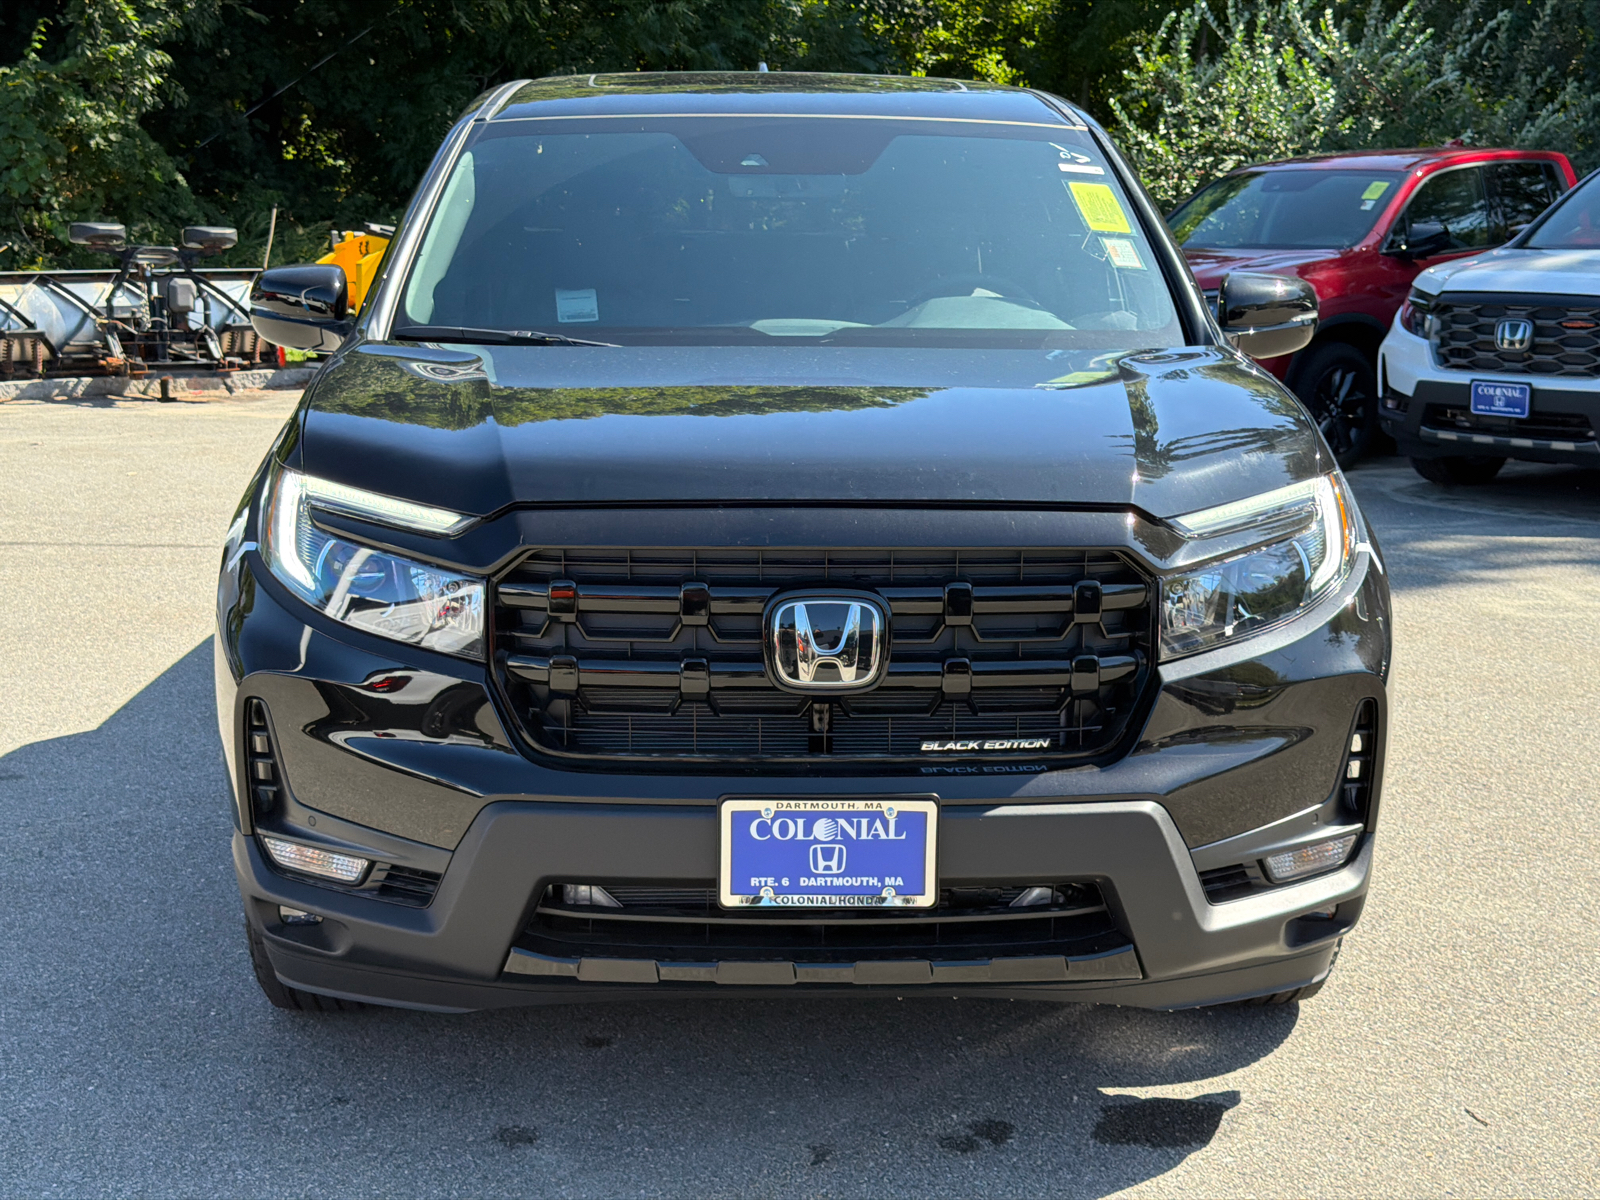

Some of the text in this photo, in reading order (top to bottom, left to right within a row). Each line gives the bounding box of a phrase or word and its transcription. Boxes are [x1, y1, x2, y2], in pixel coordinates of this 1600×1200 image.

[921, 739, 1050, 750] BLACK EDITION
[776, 802, 883, 810] DARTMOUTH, MA
[749, 817, 907, 841] COLONIAL
[750, 876, 904, 888] RTE. 6 DARTMOUTH, MA
[774, 896, 834, 905] COLONIAL
